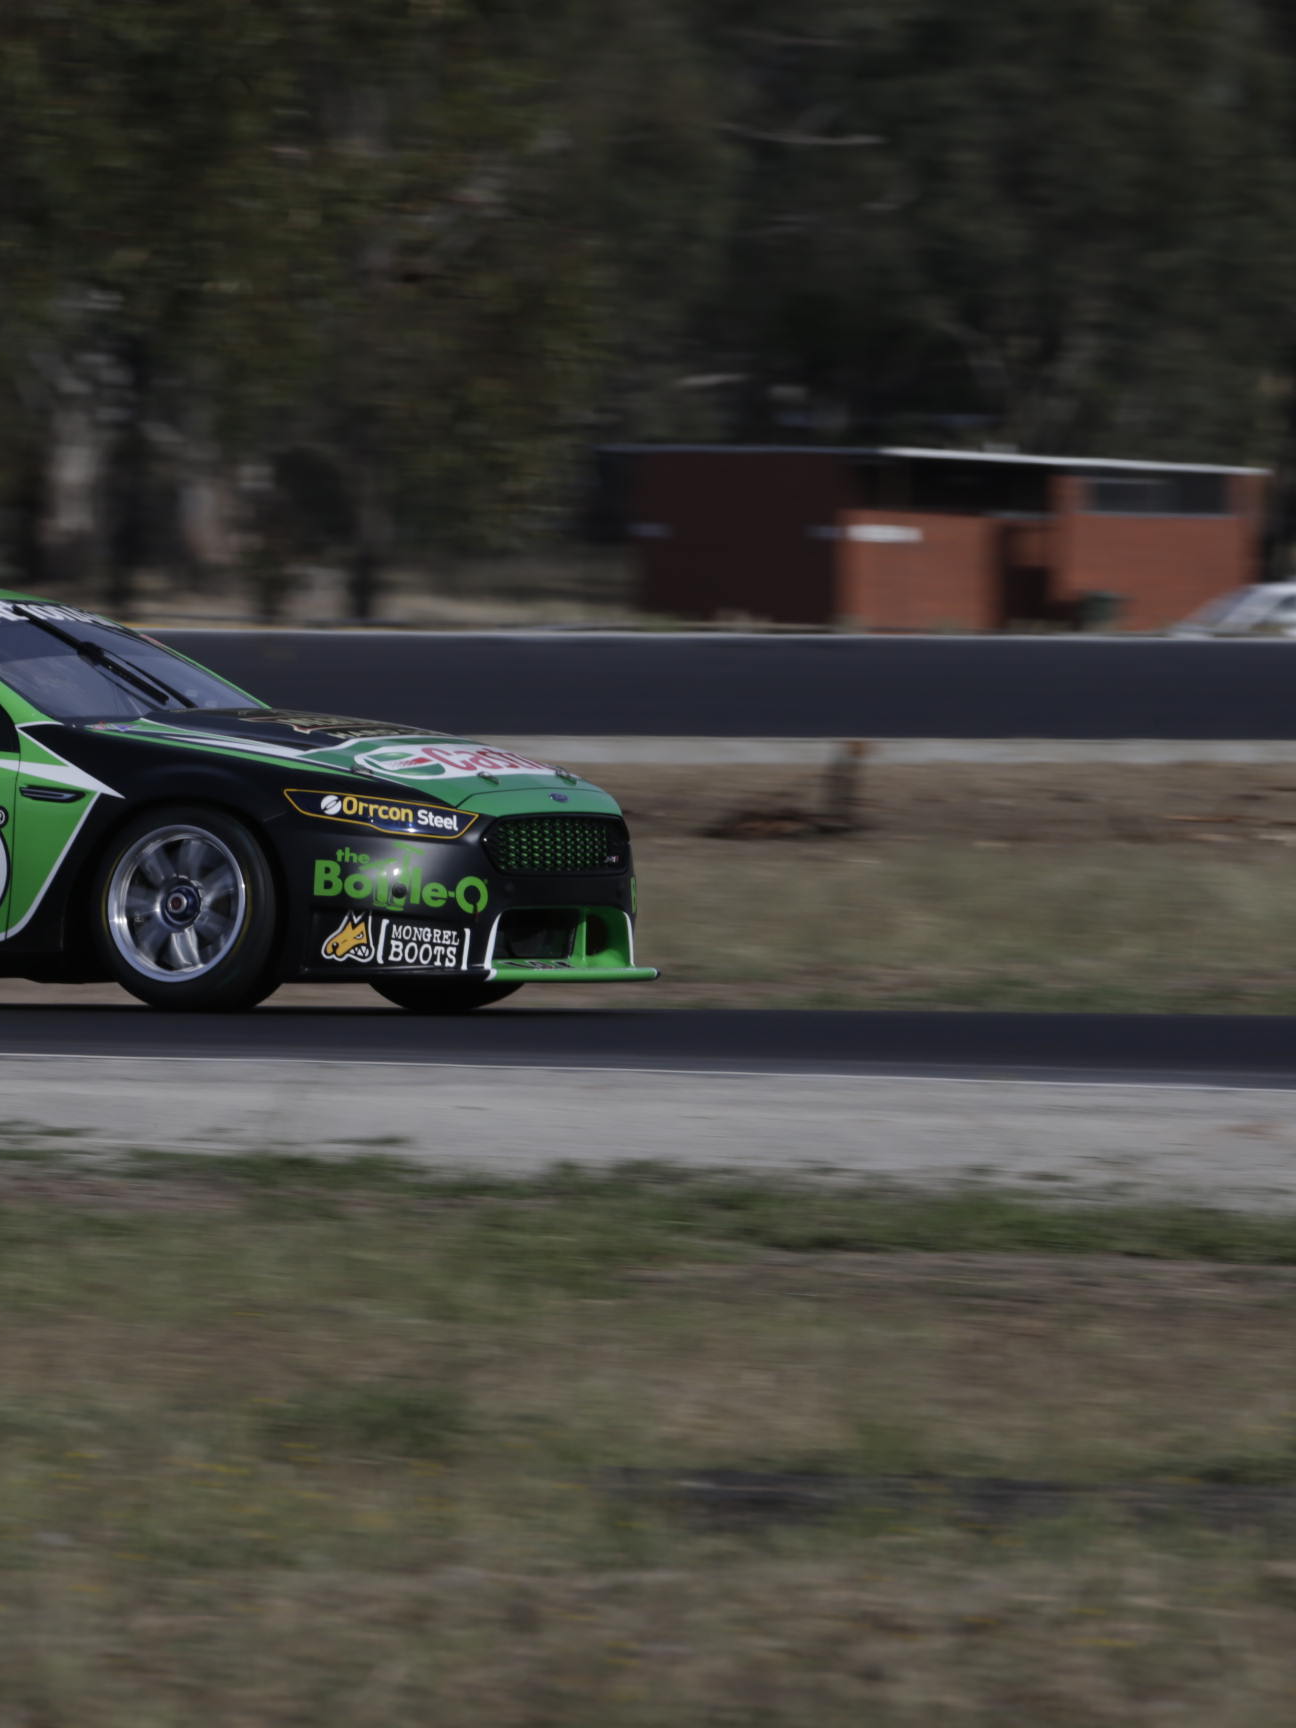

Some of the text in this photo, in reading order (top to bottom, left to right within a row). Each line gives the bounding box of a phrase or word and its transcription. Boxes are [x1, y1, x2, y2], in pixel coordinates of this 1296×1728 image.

[342, 796, 459, 831] Orrcon Steel
[336, 847, 370, 864] the
[391, 924, 460, 945] MONGREL
[388, 940, 457, 967] BOOTS
